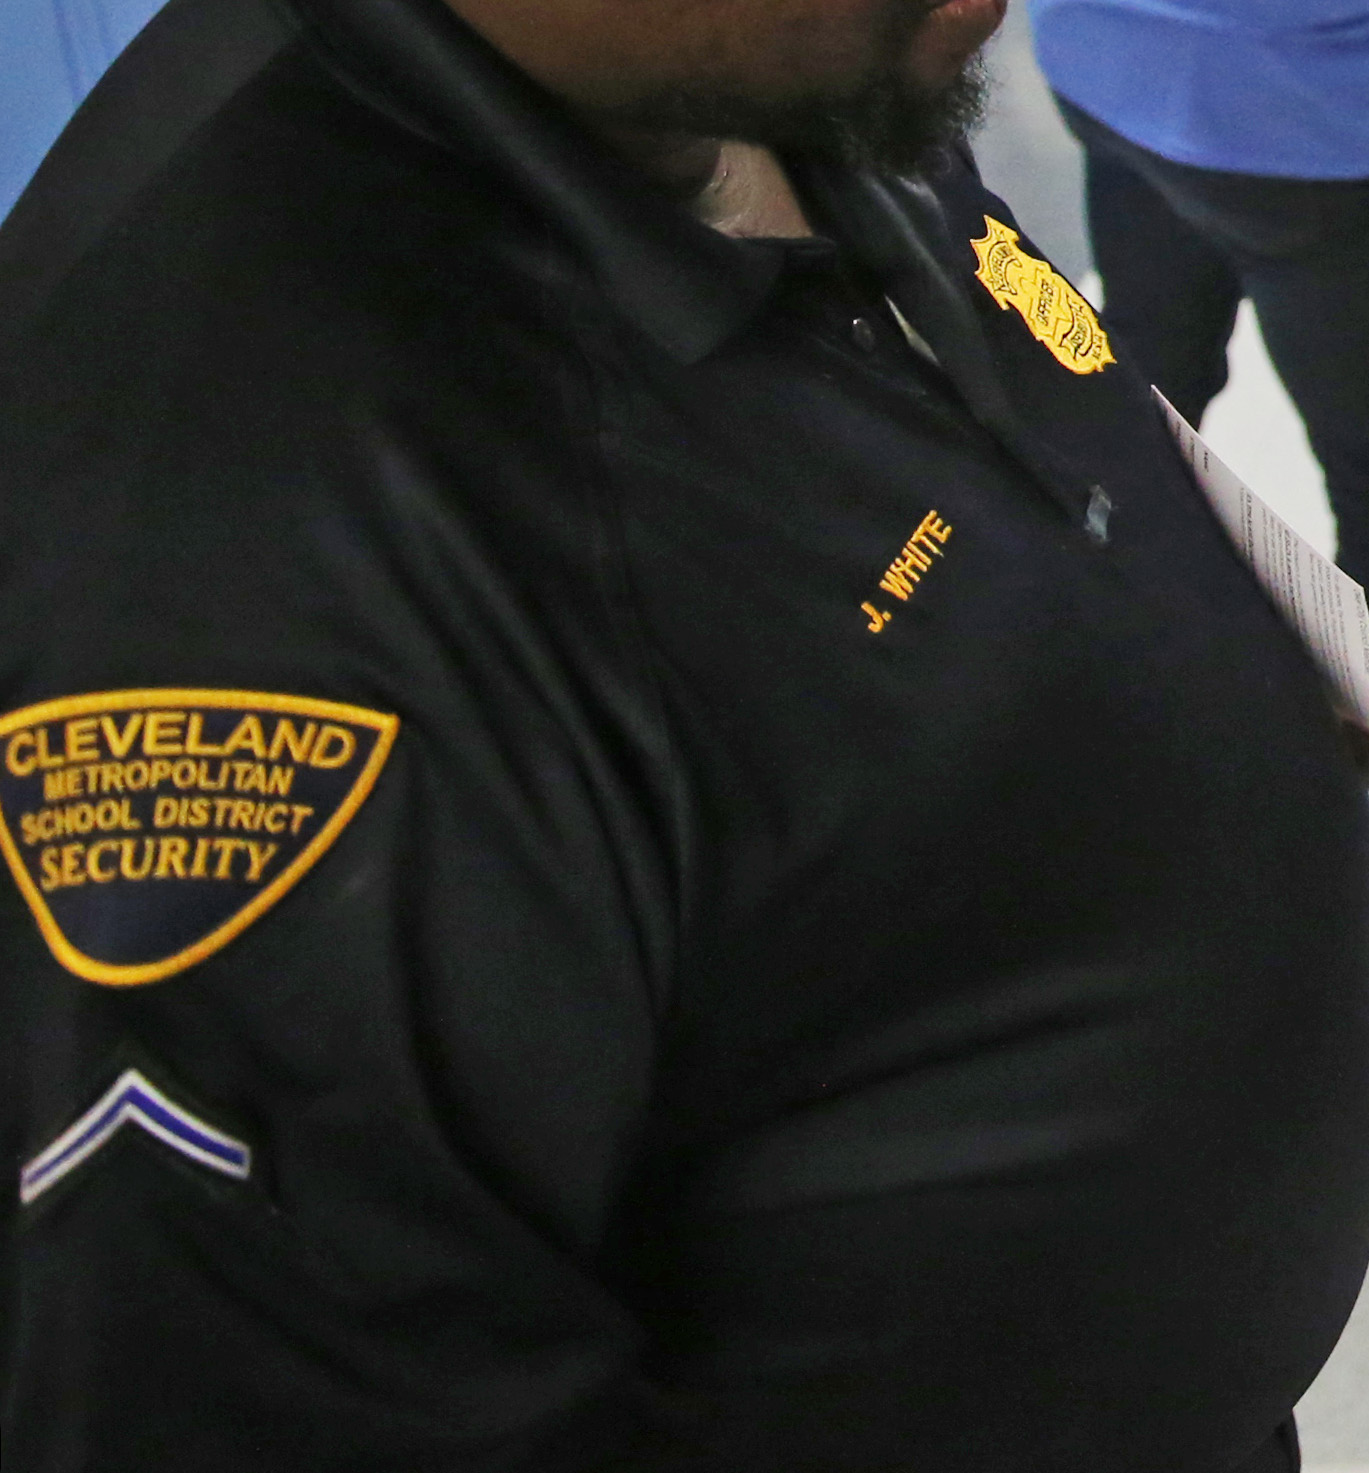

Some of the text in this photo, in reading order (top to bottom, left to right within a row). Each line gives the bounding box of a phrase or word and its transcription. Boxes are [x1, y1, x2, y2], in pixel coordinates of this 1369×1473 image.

[860, 509, 952, 634] J. WHITE
[5, 711, 358, 777] CLEVELAND
[43, 758, 295, 801] METROPOLITAN
[20, 796, 314, 845] SCHOOL DISTRICT
[39, 835, 279, 891] SECURITY
